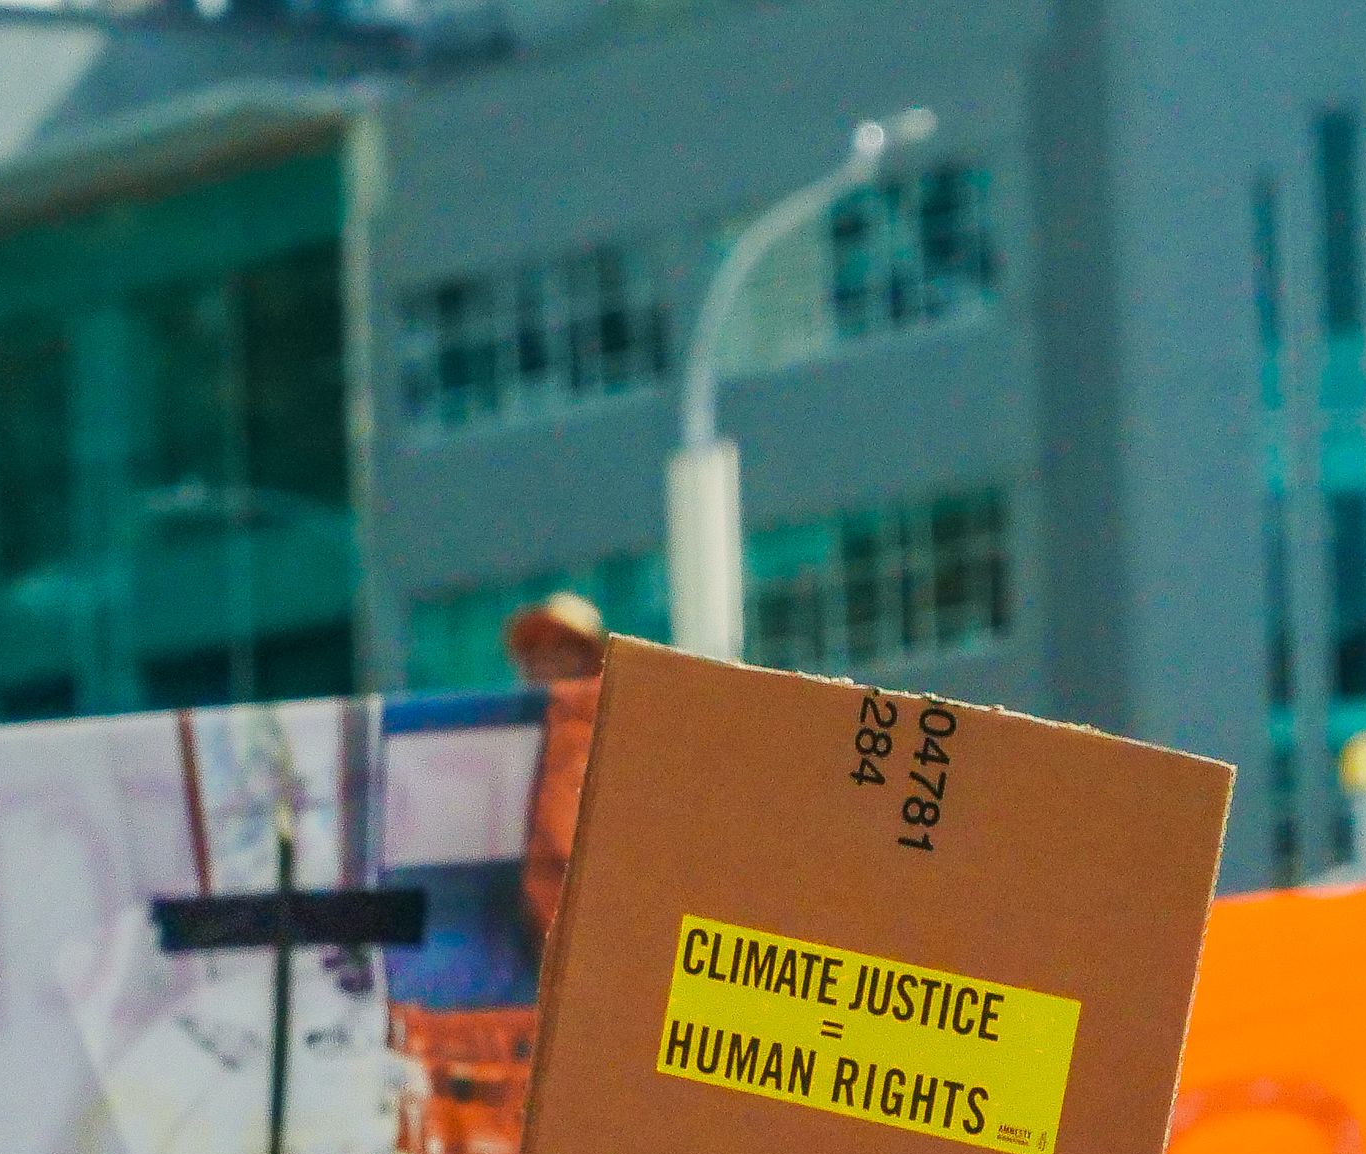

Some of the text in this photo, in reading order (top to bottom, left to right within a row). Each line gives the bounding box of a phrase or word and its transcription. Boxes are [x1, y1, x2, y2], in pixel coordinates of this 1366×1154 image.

[850, 688, 898, 786] 284
[897, 700, 958, 851] 04781
[683, 928, 1005, 1042] CLIMATE JUSTICE
[665, 1019, 990, 1136] HUMAN RIGHTS
